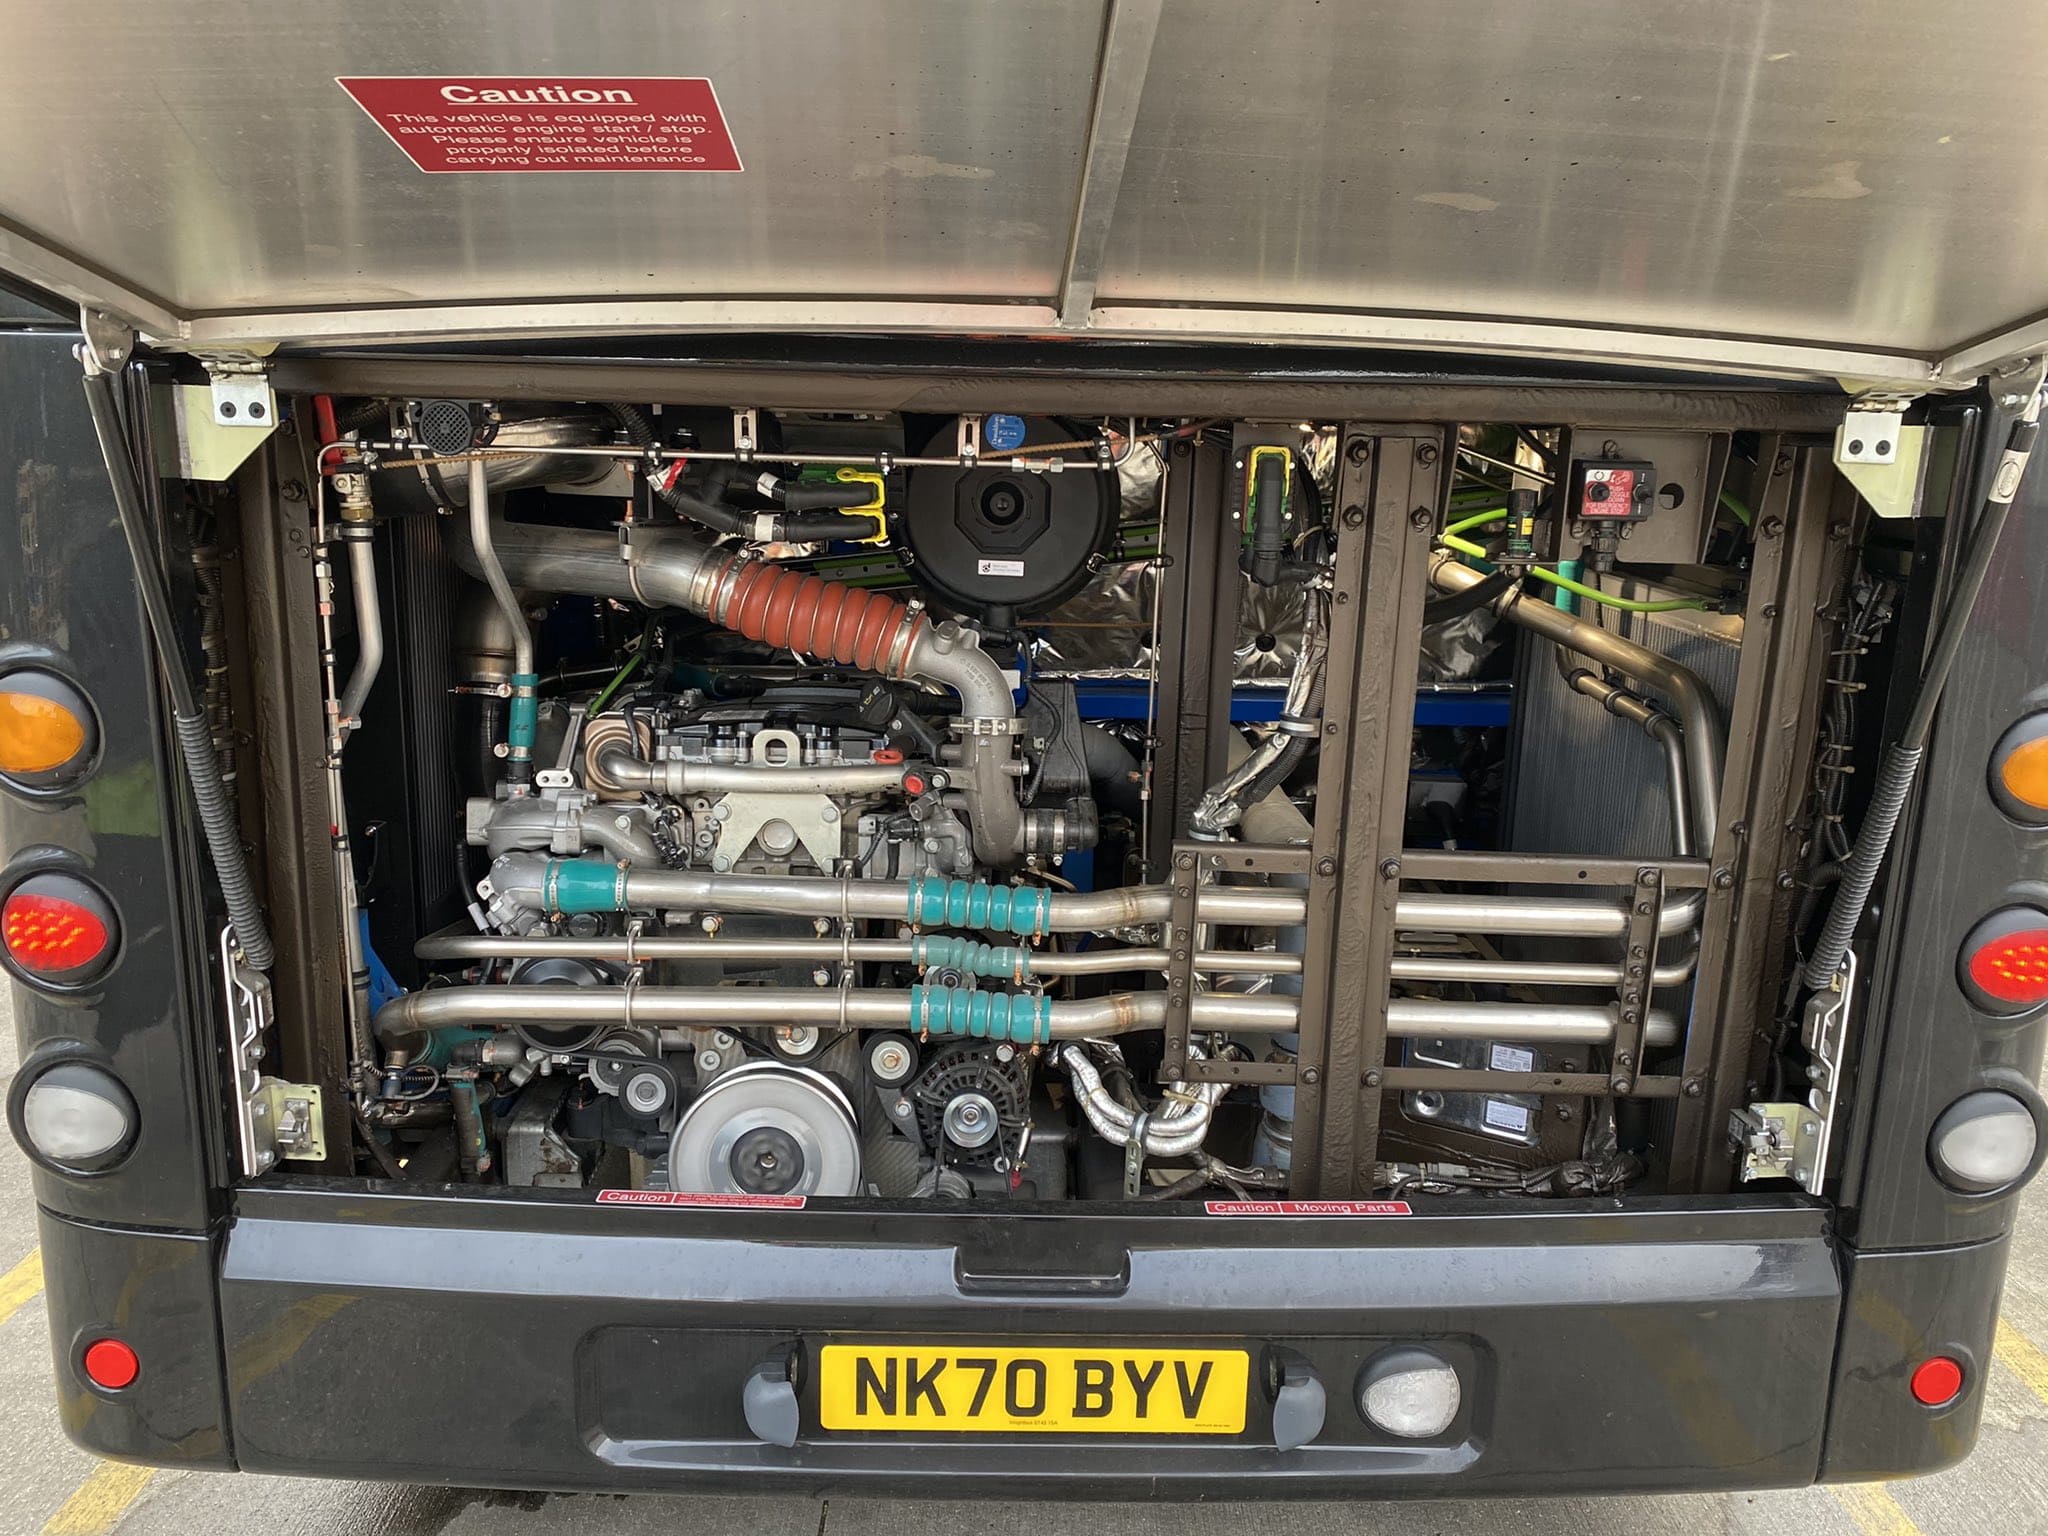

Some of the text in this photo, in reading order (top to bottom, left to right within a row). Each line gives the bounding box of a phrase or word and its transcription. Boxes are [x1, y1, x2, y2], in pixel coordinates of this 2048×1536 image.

[440, 85, 634, 103] Caution
[386, 113, 707, 124] This vehicle is equipped with
[399, 124, 507, 134] automatic
[513, 124, 586, 136] engine
[592, 125, 640, 134] start
[660, 124, 712, 135] stop.
[432, 134, 693, 144] Please ensure vehicle is
[446, 145, 693, 156] properly isolated before
[446, 155, 706, 165] carrying out maintenance
[606, 1192, 667, 1202] Caution
[1214, 1203, 1397, 1214] Caution Moving Parts
[855, 1357, 1215, 1419] NK70 BYV
